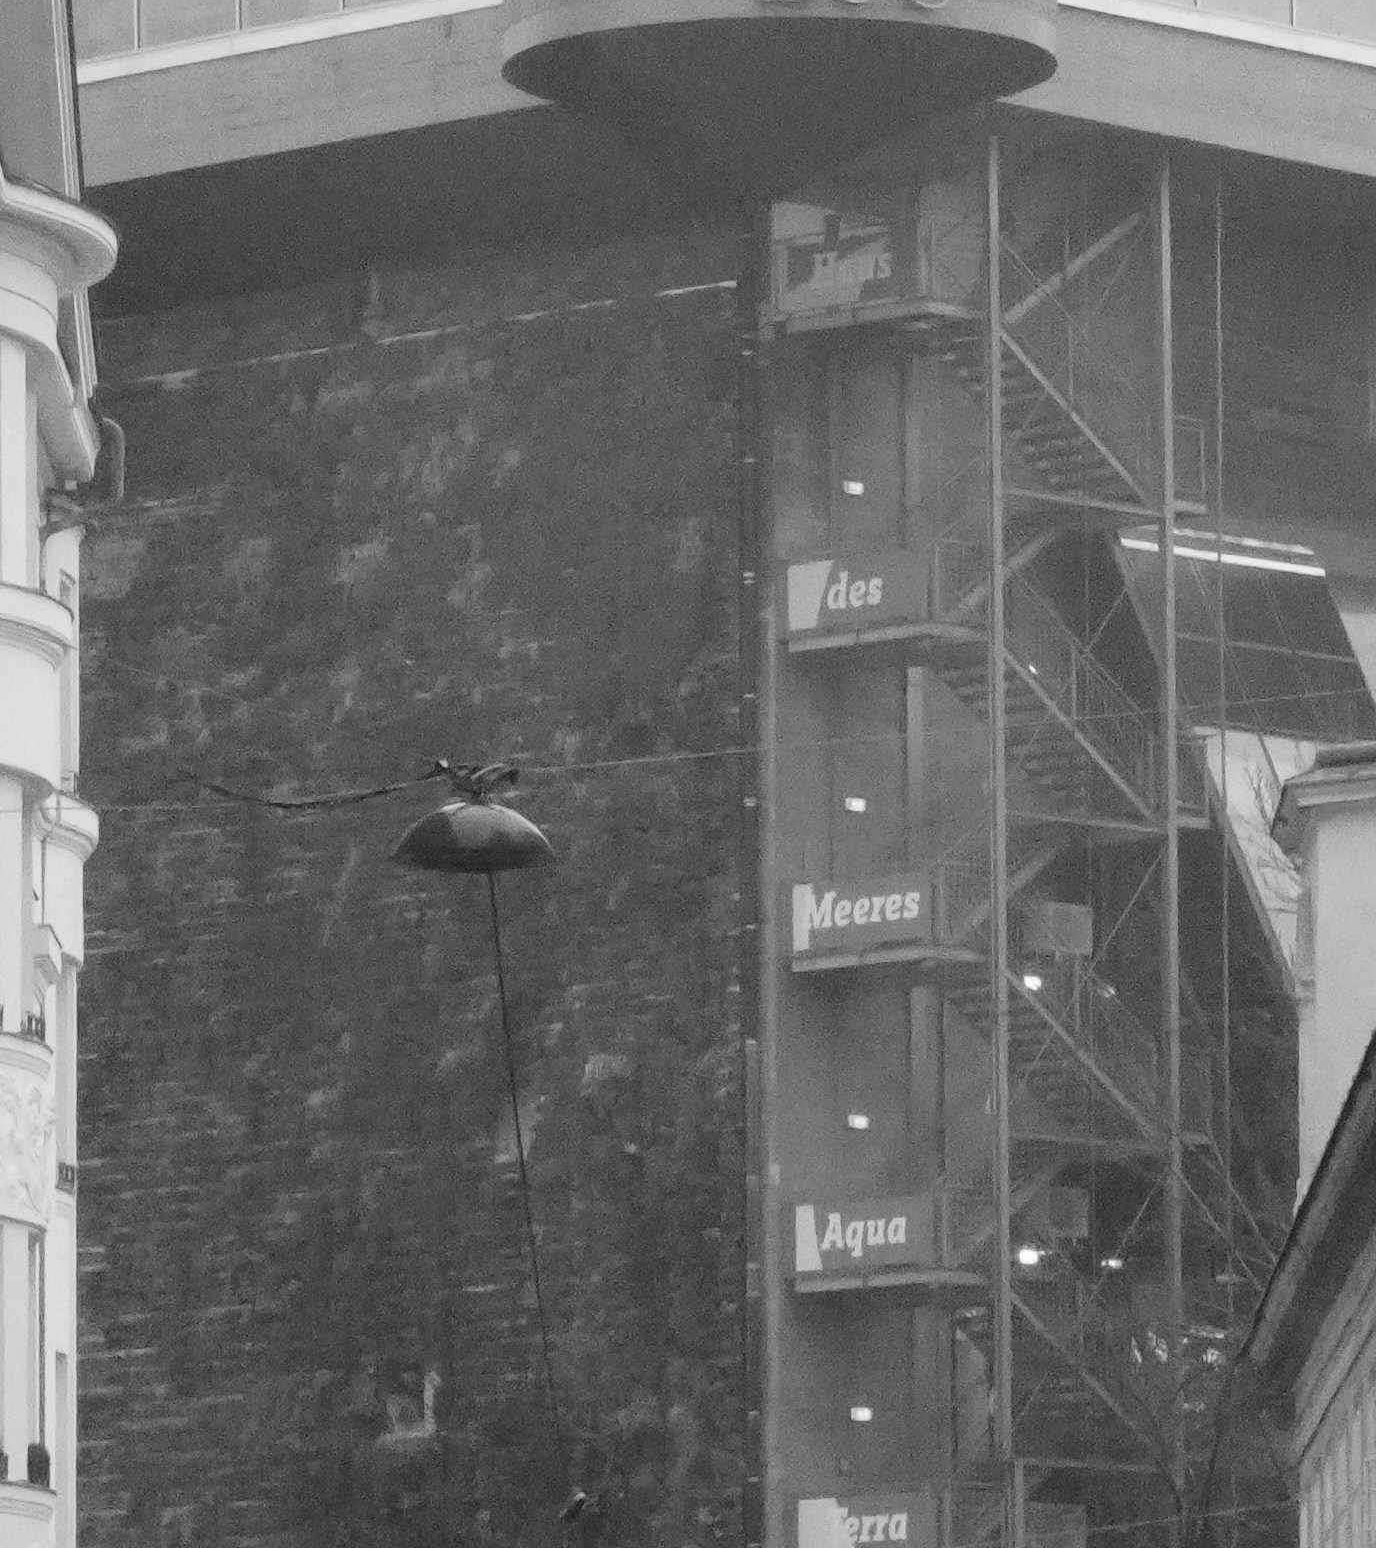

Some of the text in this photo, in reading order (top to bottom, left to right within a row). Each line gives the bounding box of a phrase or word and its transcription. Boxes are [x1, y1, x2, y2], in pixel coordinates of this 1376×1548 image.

[826, 570, 884, 610] des
[808, 890, 921, 929] Meeres
[821, 1212, 907, 1258] Aqua
